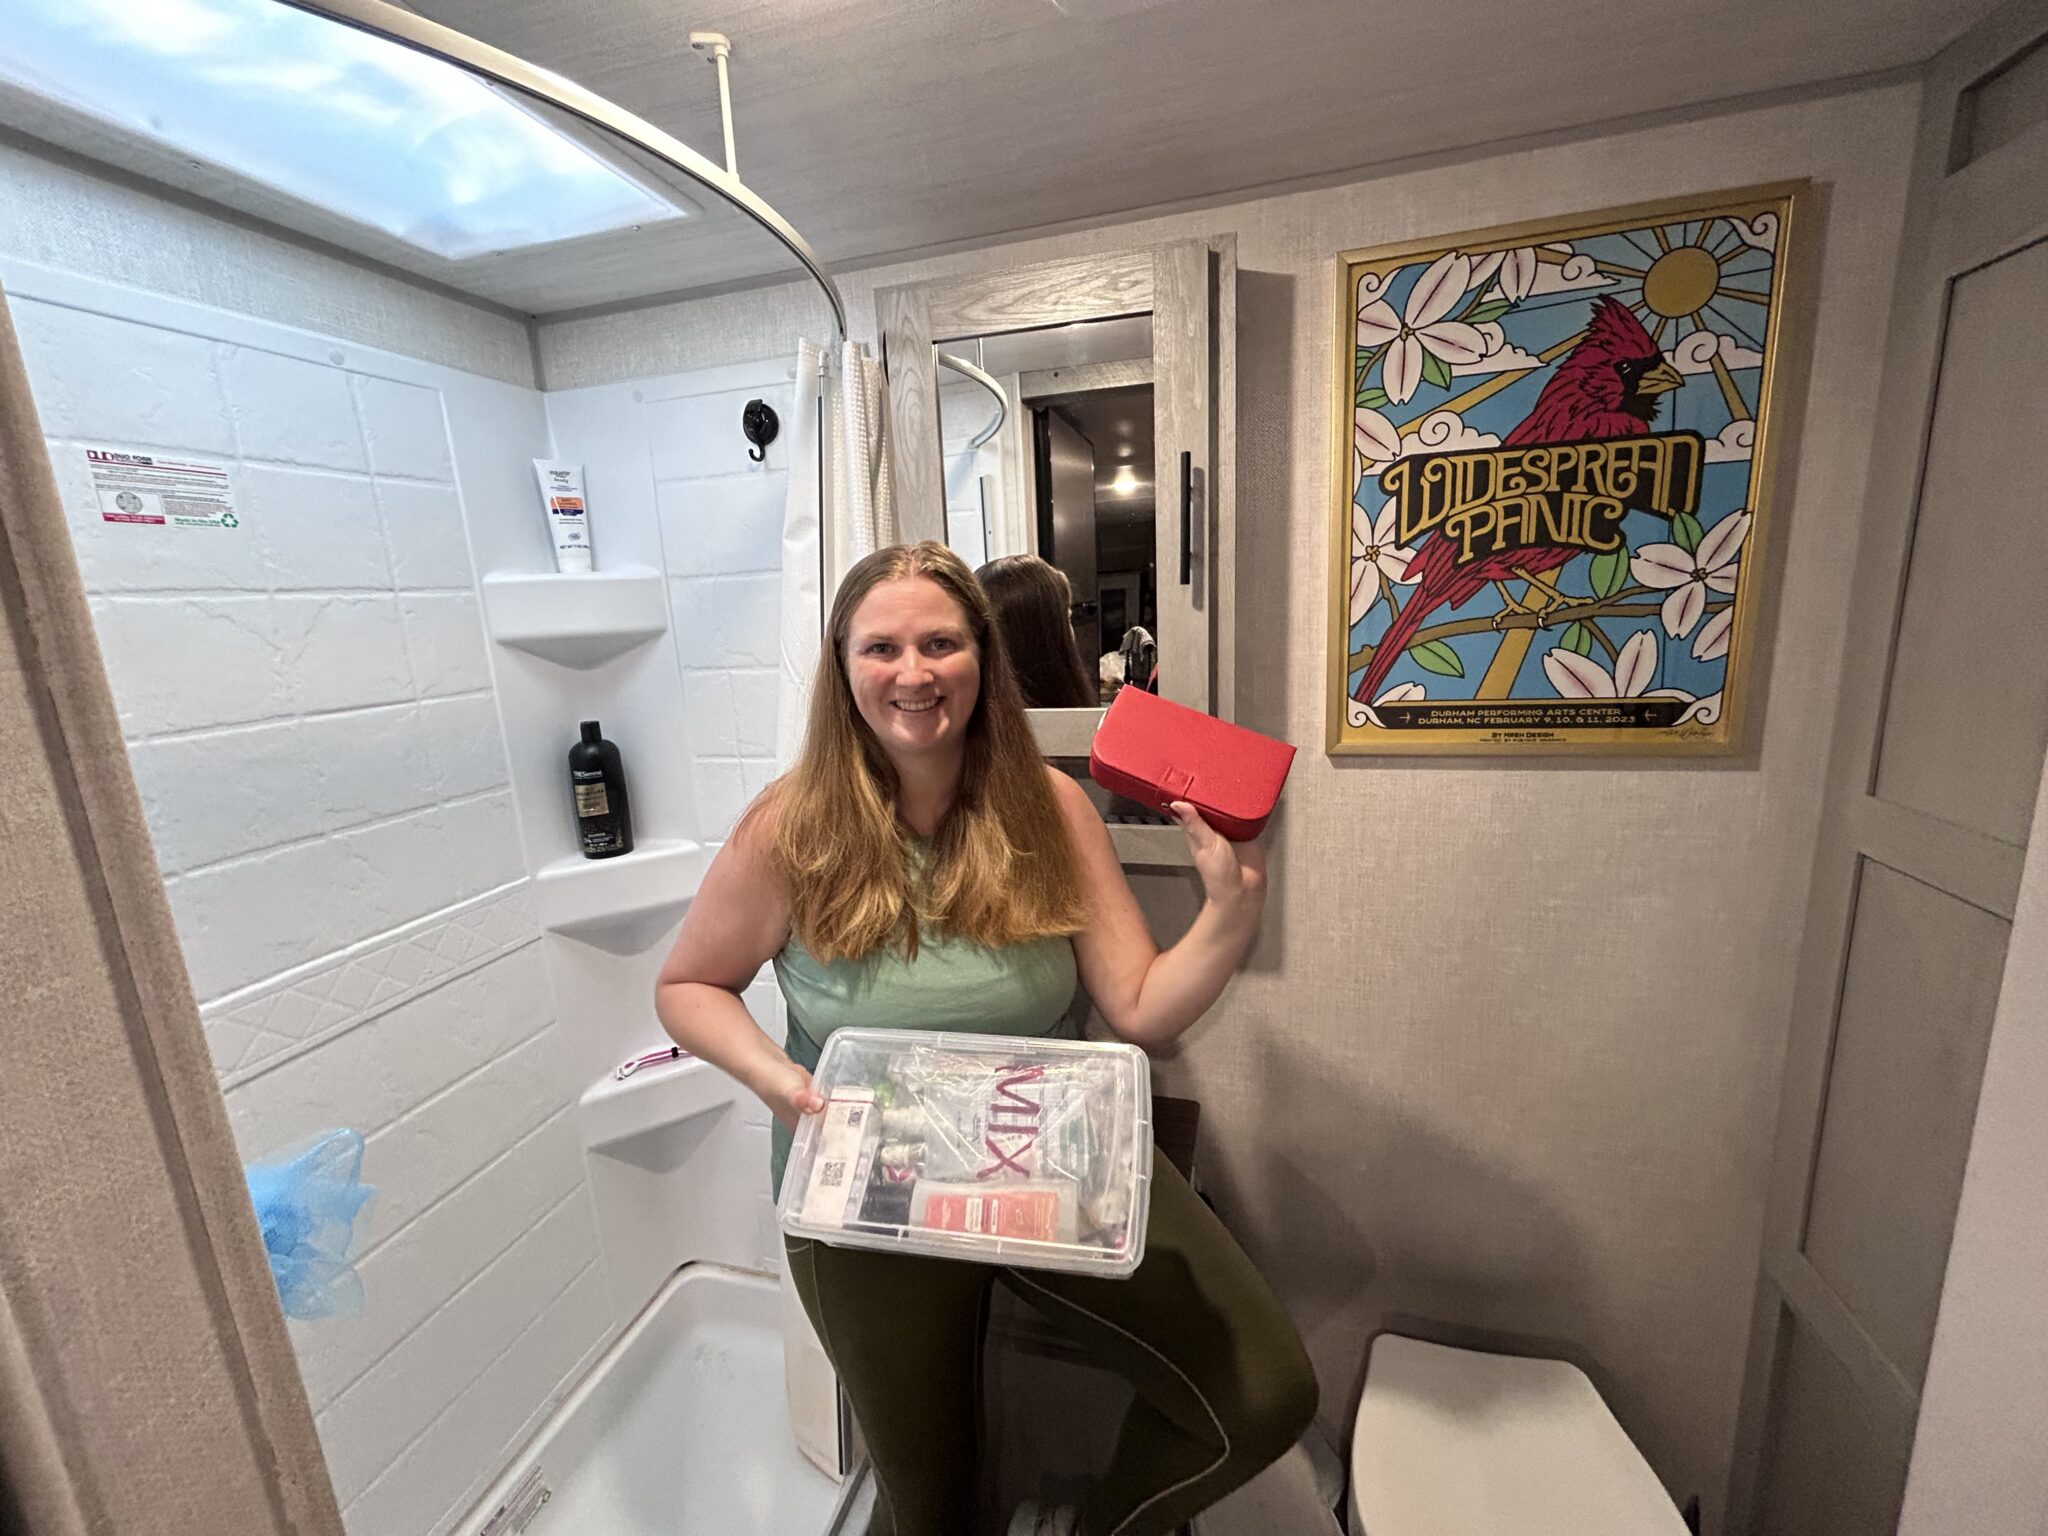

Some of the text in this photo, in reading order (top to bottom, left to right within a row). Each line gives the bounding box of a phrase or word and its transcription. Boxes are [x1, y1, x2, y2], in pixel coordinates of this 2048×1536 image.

[1383, 434, 1701, 544] WIDESPREAD
[1444, 492, 1625, 565] PANIC
[1418, 717, 1465, 725] DURHAM,
[1467, 717, 1481, 725] NC
[1484, 716, 1541, 725] FEBRUARY
[1575, 716, 1585, 724] &
[1605, 715, 1637, 723] 2023
[1430, 707, 1622, 717] DURHAM PERFORMING ARTS CENTER
[976, 1064, 1047, 1180] MIX
